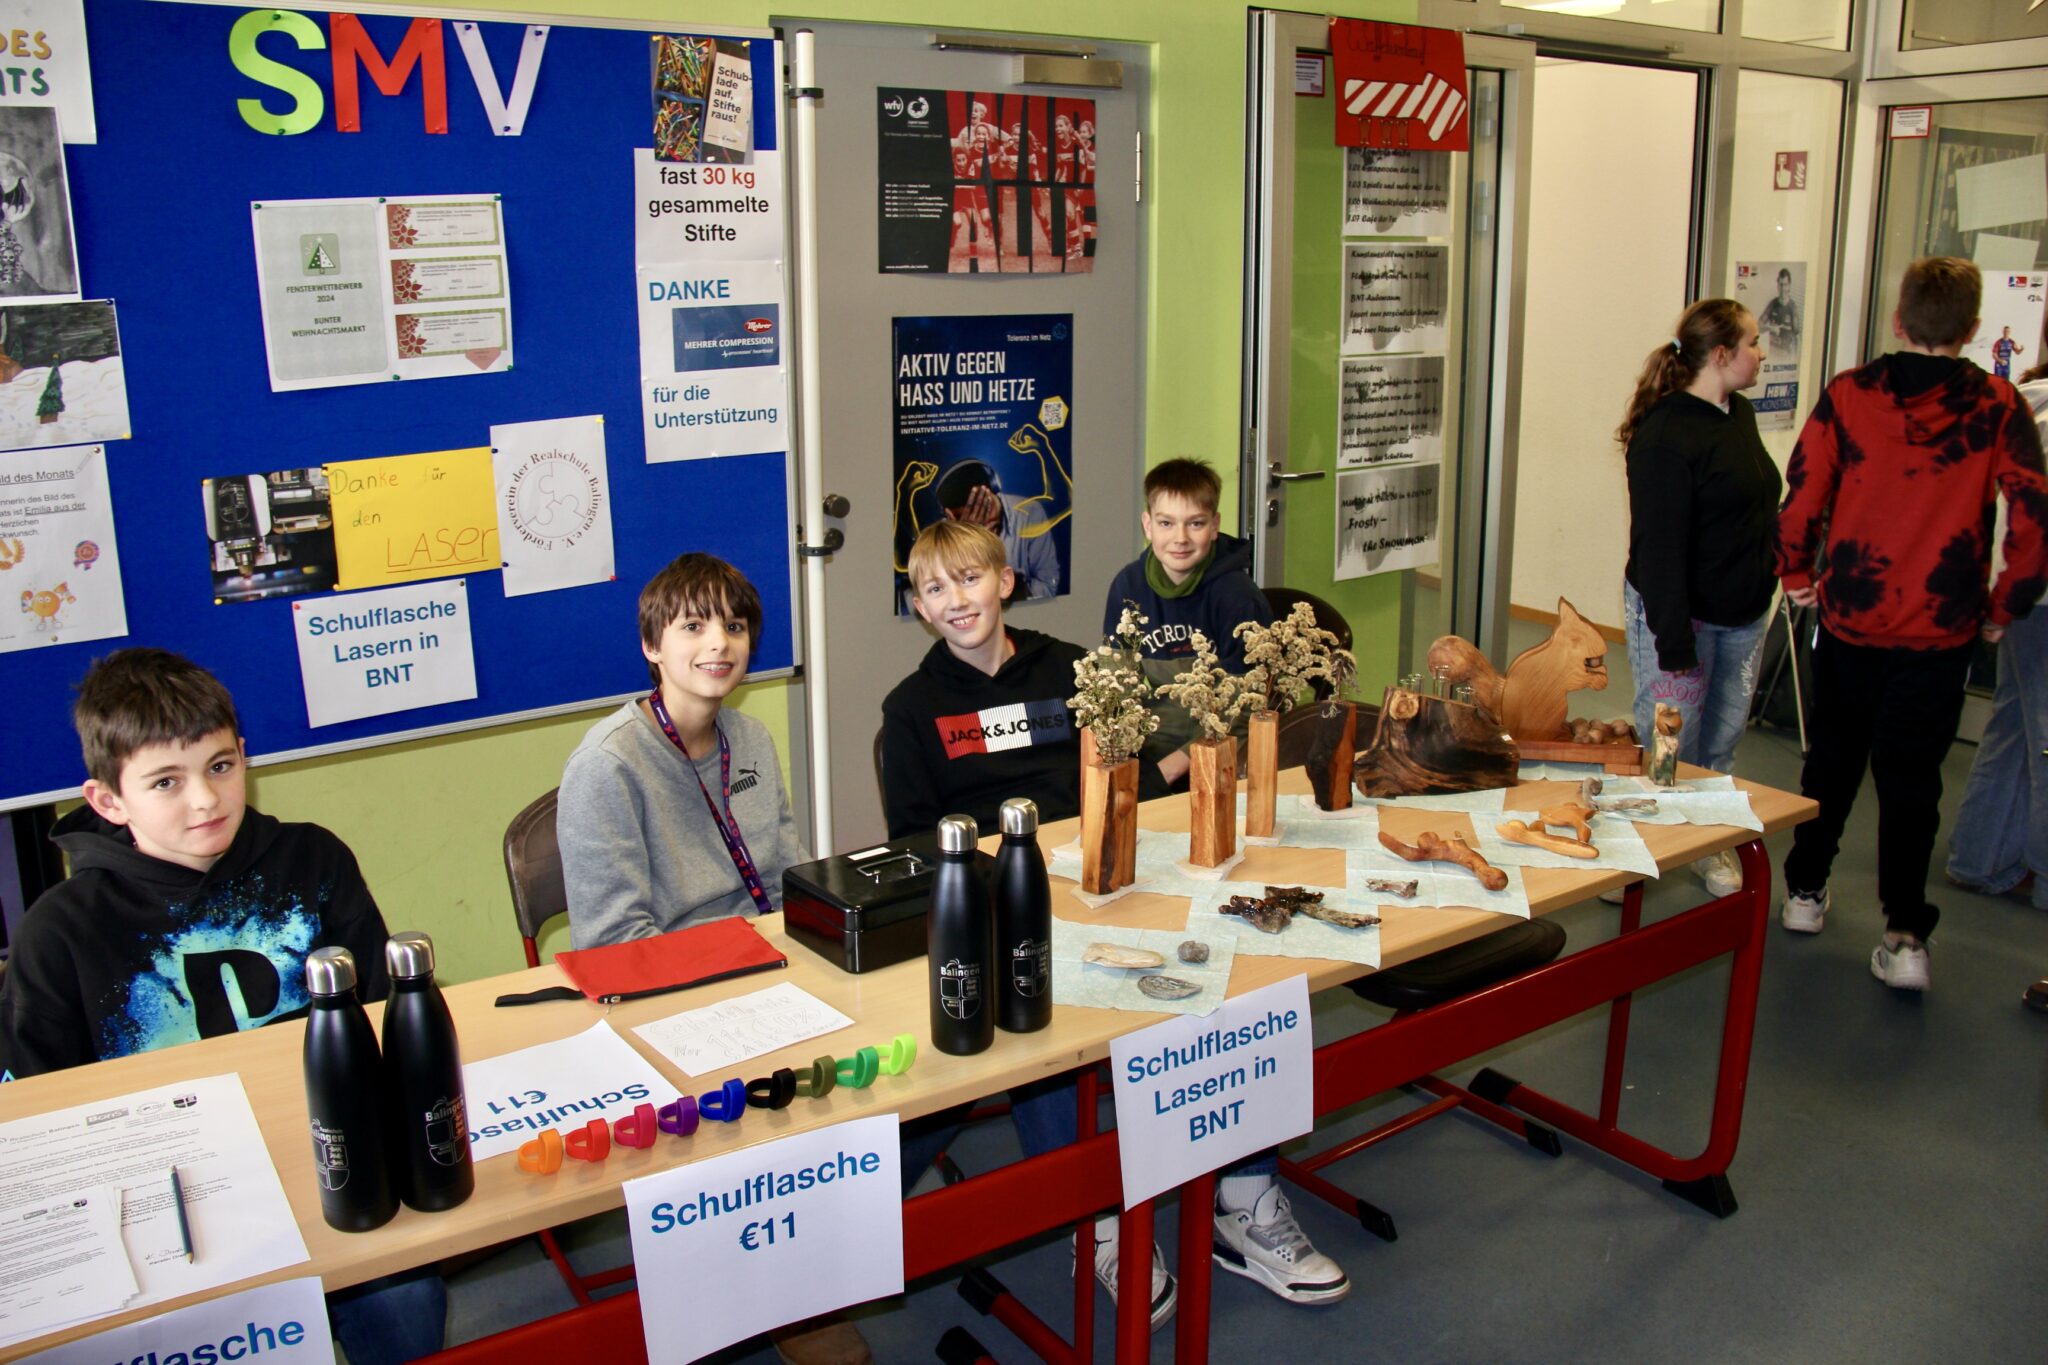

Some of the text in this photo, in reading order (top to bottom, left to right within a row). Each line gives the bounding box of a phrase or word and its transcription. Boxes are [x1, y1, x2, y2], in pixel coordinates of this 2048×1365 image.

[228, 10, 550, 136] SMV
[716, 76, 738, 90] lade
[718, 66, 752, 82] Schub-
[714, 87, 733, 100] auf,
[711, 110, 737, 124] raus!
[713, 99, 741, 114] Stifte
[660, 167, 755, 189] fast 30 kg
[649, 196, 769, 218] gesammelte
[685, 224, 736, 242] Stifte
[286, 282, 363, 294] FENSTERWETTBEWERB
[317, 295, 335, 303] 2024
[649, 279, 730, 301] DANKE
[291, 325, 366, 337] WEIHNACHTSMARKT
[314, 316, 341, 325] BUNTER
[684, 337, 774, 350] MEHRER COMPRESSION
[899, 351, 1006, 378] AKTIV GEGEN
[653, 385, 710, 403] für die
[900, 378, 1036, 407] HASS UND HETZE
[654, 408, 777, 429] Unterstützung
[14, 474, 33, 483] des
[36, 469, 75, 481] Monats
[329, 468, 399, 495] Danke
[513, 463, 529, 484] der
[530, 449, 590, 477] Realschule
[582, 477, 602, 532] Balingen
[352, 511, 381, 528] den
[308, 601, 457, 636] Schulflasche
[334, 632, 439, 663] Lasern in
[366, 663, 413, 688] BNT
[947, 714, 1066, 745] JACK&JONES
[1013, 944, 1049, 957] Balingen
[940, 966, 980, 978] Balingen
[1127, 1010, 1298, 1084] Schulflasche
[1154, 1056, 1276, 1115] Lasern in
[487, 1090, 548, 1115] €11
[1189, 1099, 1245, 1142] BNT
[651, 1151, 881, 1234] Schulflasche
[738, 1211, 796, 1251] €11
